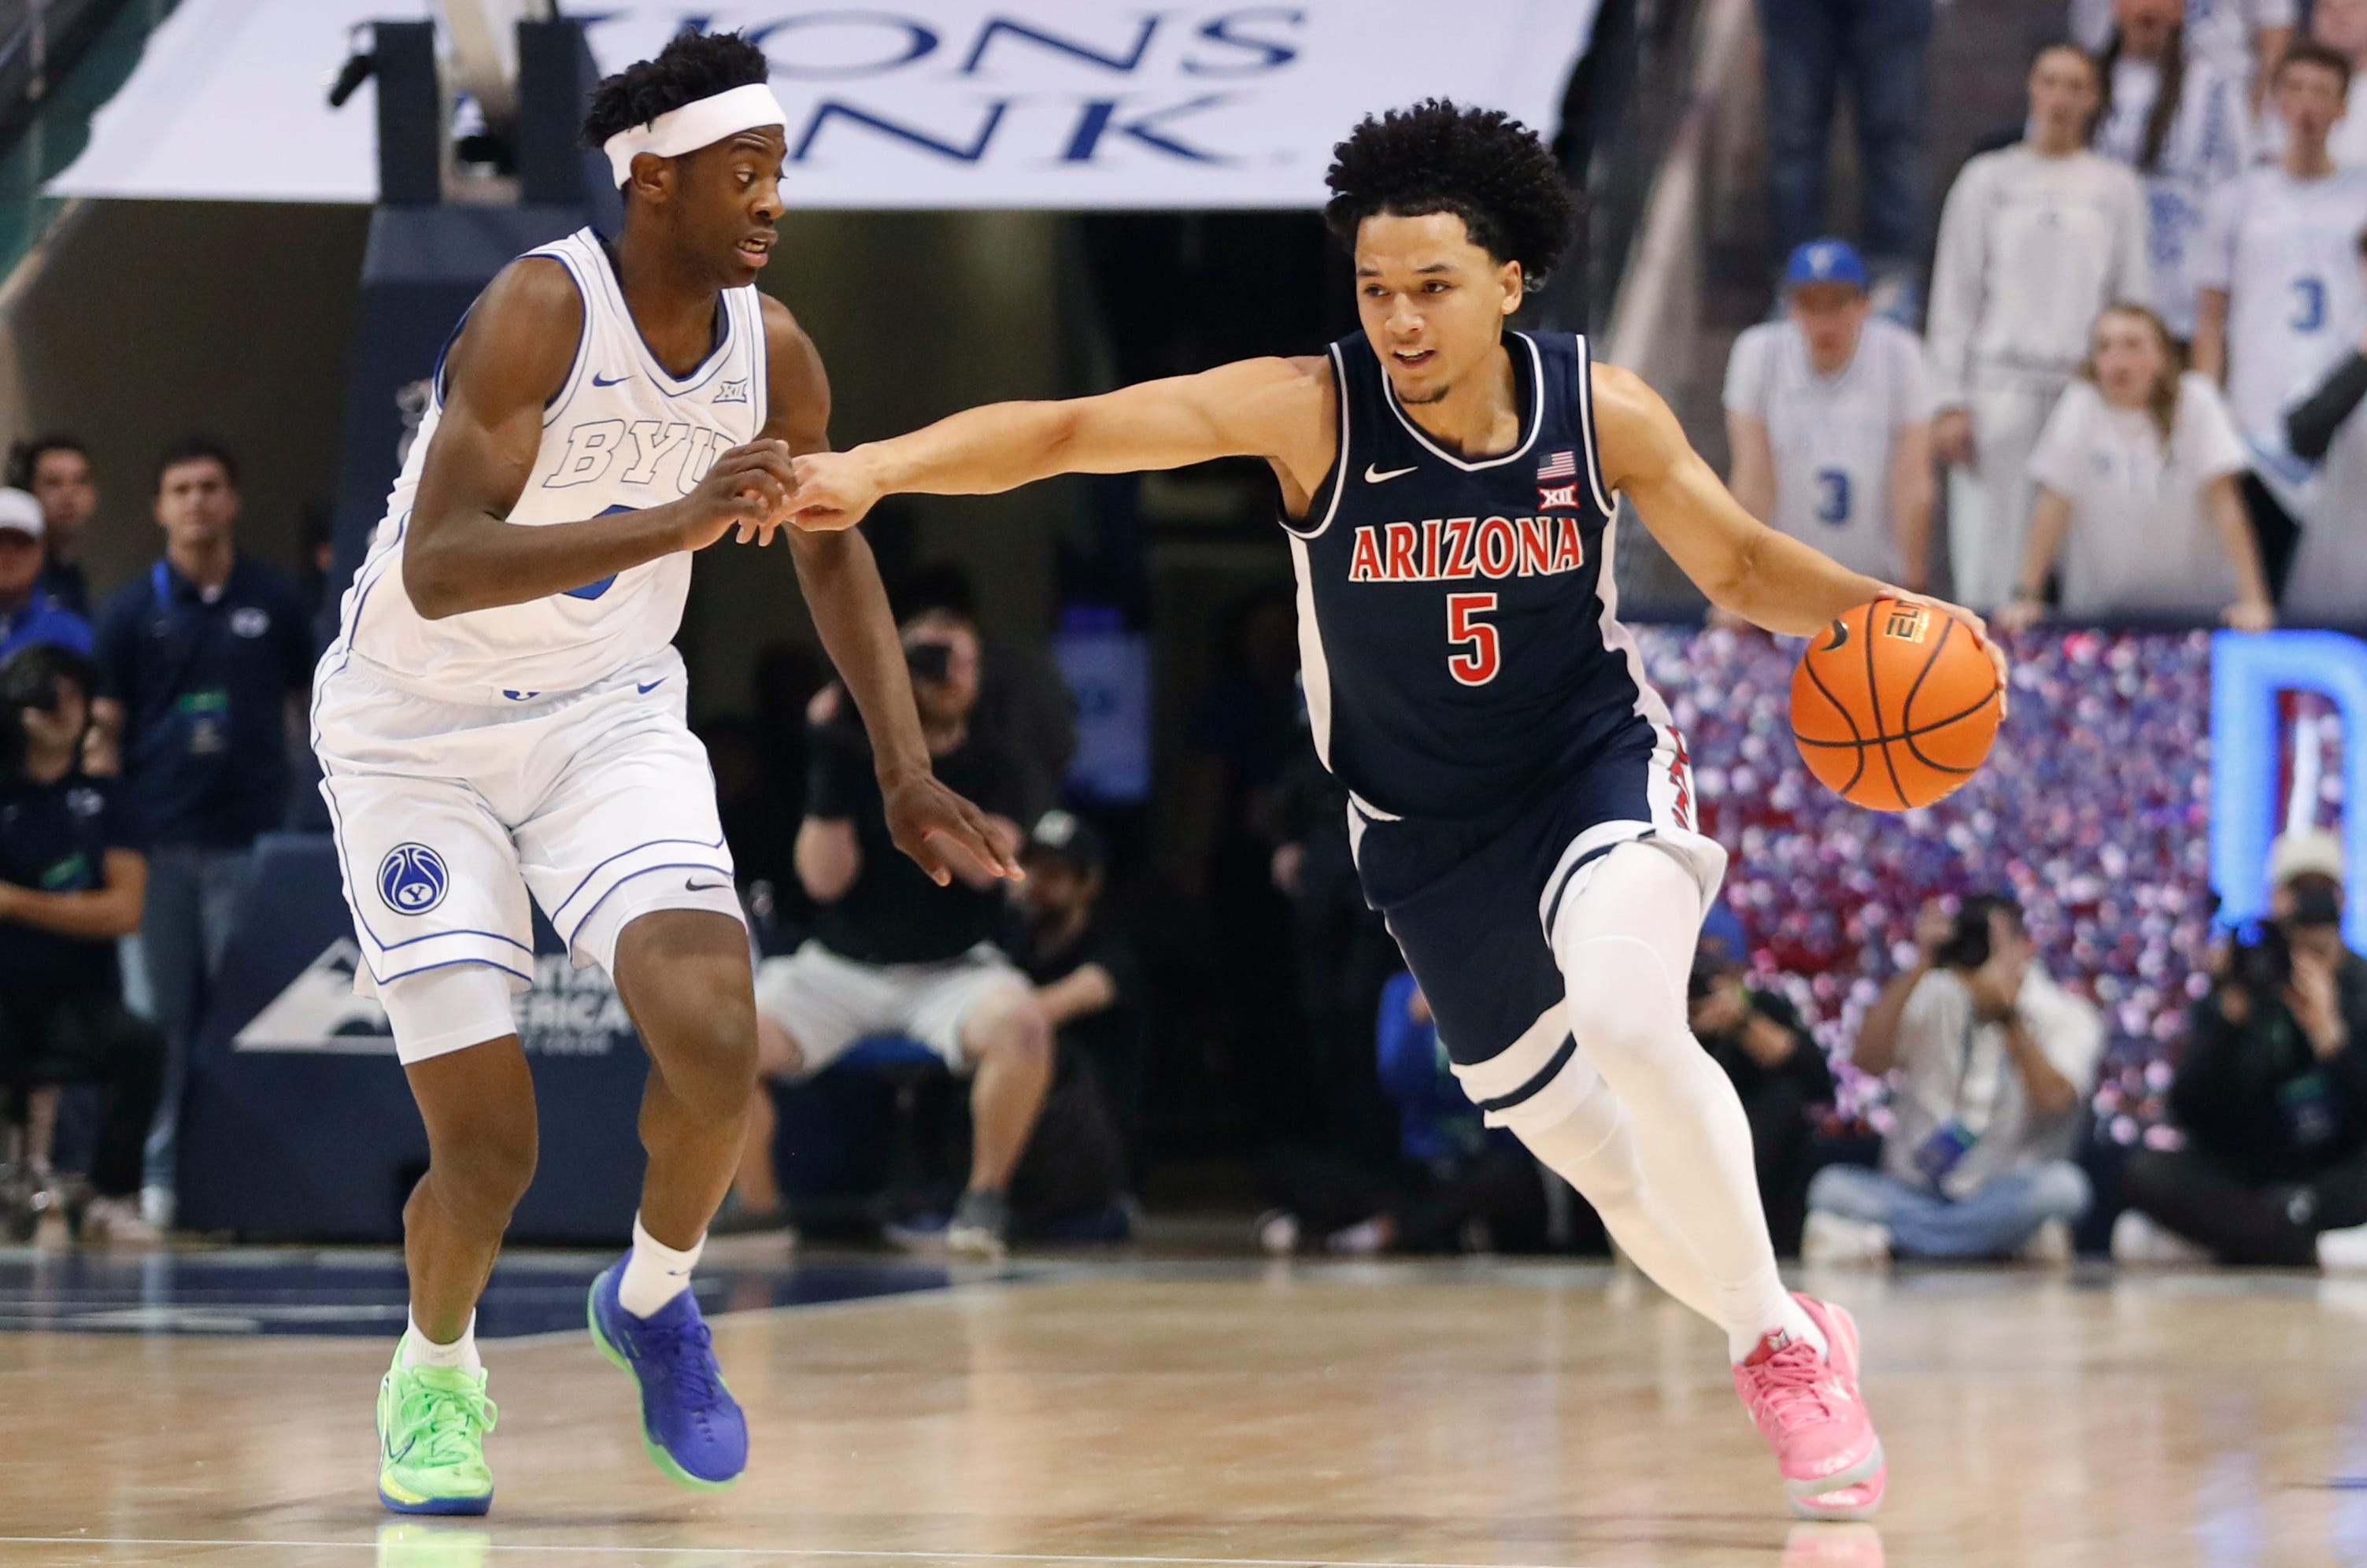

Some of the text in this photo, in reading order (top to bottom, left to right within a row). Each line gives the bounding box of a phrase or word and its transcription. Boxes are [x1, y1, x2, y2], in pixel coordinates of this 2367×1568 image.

[560, 6, 1307, 82] ONS
[786, 91, 1263, 168] NK
[2291, 277, 2326, 332] 3
[542, 419, 738, 497] BYU
[1538, 483, 1580, 512] XII
[1814, 465, 1850, 526] 3
[1348, 516, 1584, 583] ARIZONA
[1446, 592, 1501, 688] 5
[404, 885, 426, 902] Y
[510, 993, 634, 1036] ERICA
